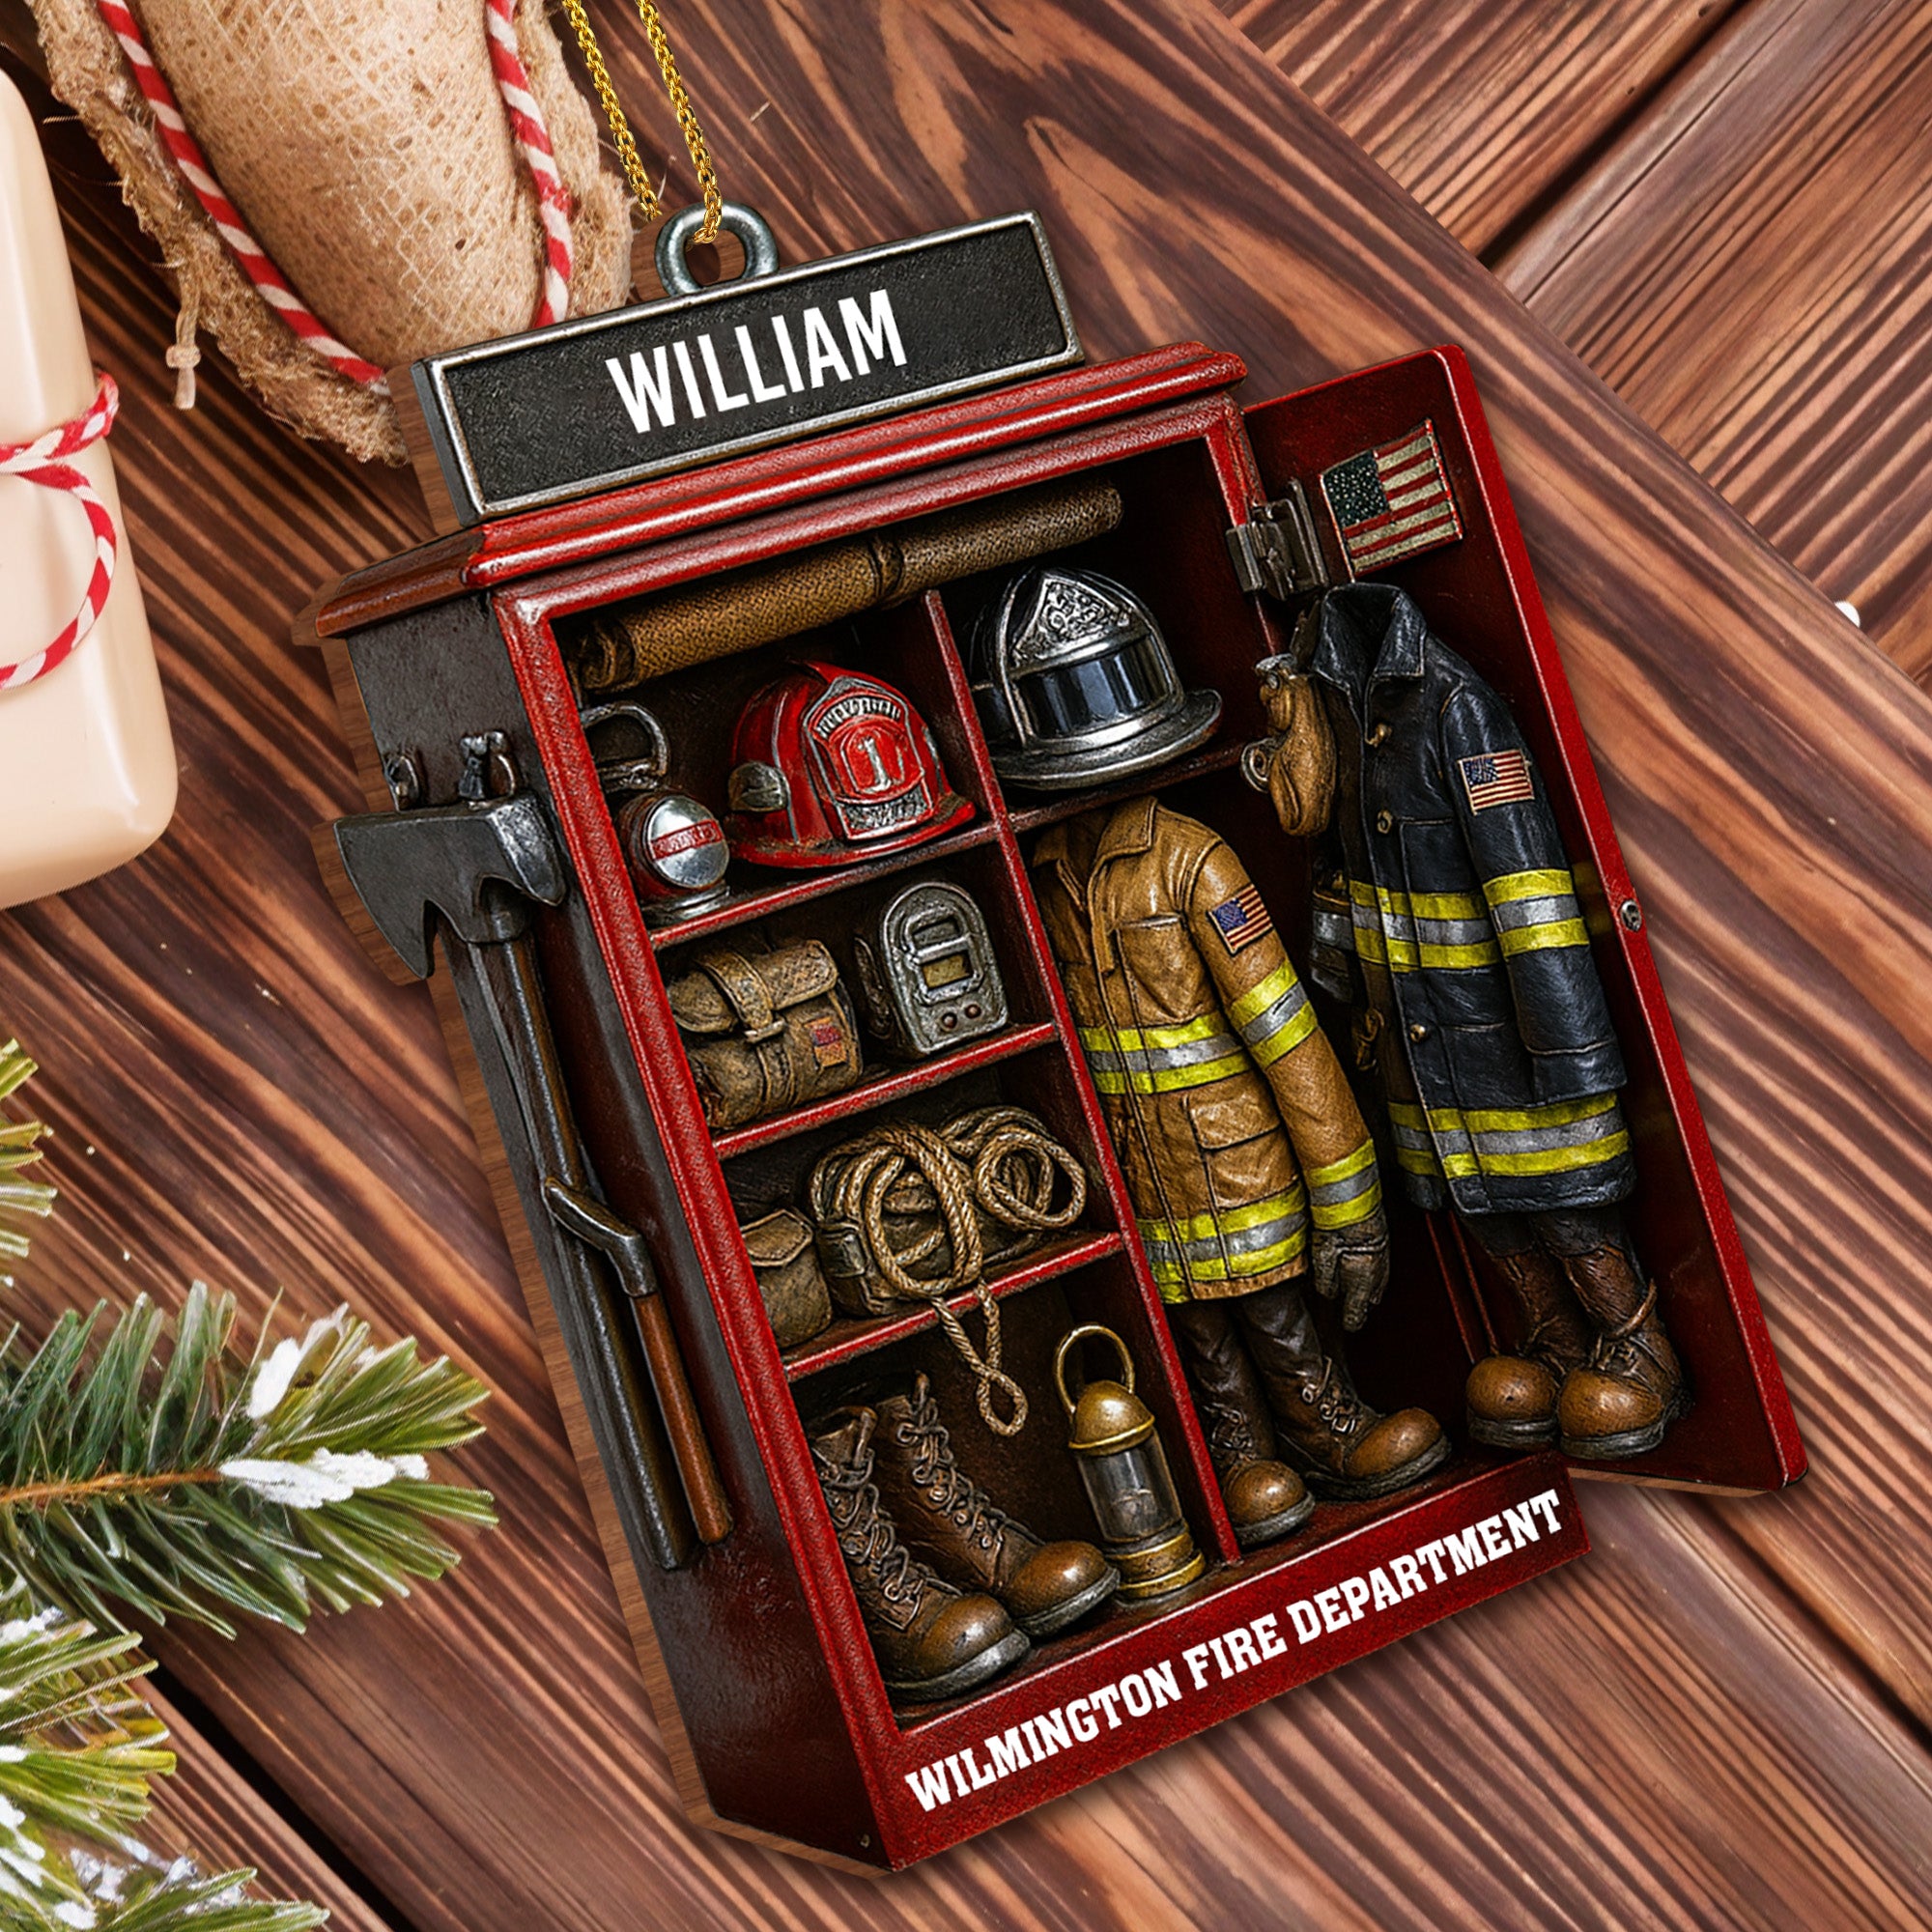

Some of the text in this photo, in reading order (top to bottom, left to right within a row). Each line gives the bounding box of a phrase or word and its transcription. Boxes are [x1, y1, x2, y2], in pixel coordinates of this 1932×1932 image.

[605, 289, 908, 434] WILLIAM
[857, 737, 892, 794] 1
[904, 1489, 1562, 1812] WILMINGTON FIRE DEPARTMENT
